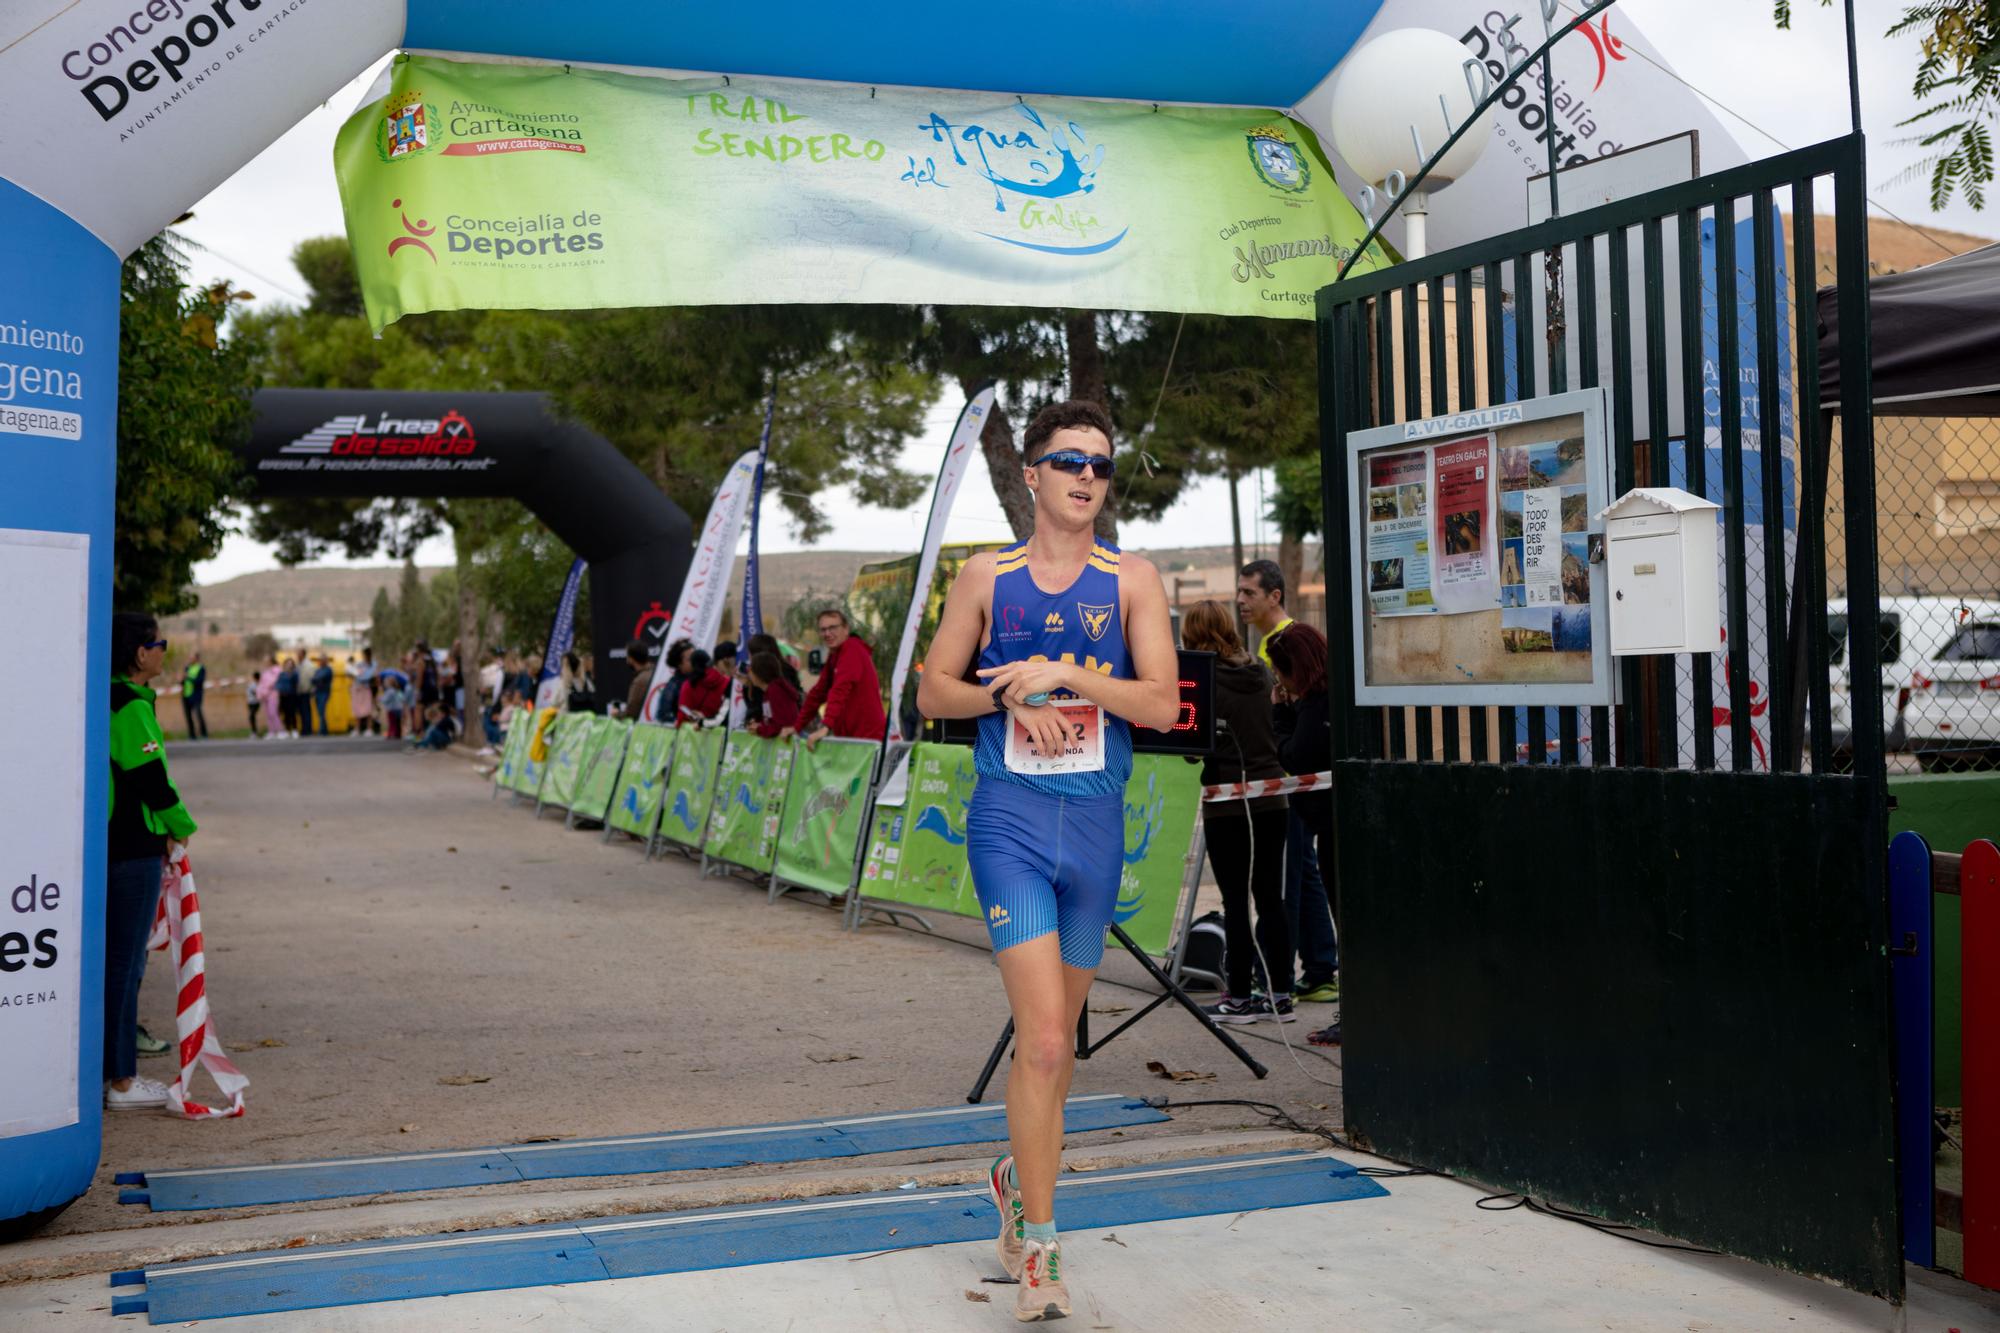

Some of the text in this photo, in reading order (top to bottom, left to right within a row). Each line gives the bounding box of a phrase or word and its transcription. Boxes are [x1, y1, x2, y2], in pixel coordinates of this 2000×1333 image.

[61, 0, 190, 81] Concej
[119, 0, 307, 143] AYUNTAMIENTO DE CARTAG
[449, 100, 580, 123] Ayuntamiento
[686, 93, 807, 124] TRAIL
[450, 117, 583, 140] Cartagena
[476, 139, 583, 152] www.cartagena.es
[692, 127, 886, 164] SENDERO
[900, 156, 950, 189] del
[446, 210, 601, 236] Concejalía de
[1018, 199, 1102, 233] Galifa
[1219, 215, 1282, 240] Club Deportivo
[447, 231, 604, 260] Deportes
[451, 260, 527, 269] AYUNTAMIENTO
[548, 259, 605, 269] CARTAGENA
[1261, 288, 1316, 306] Cartage
[355, 411, 440, 434] Linea
[1464, 448, 1488, 461] GALIFA
[11, 874, 60, 914] de
